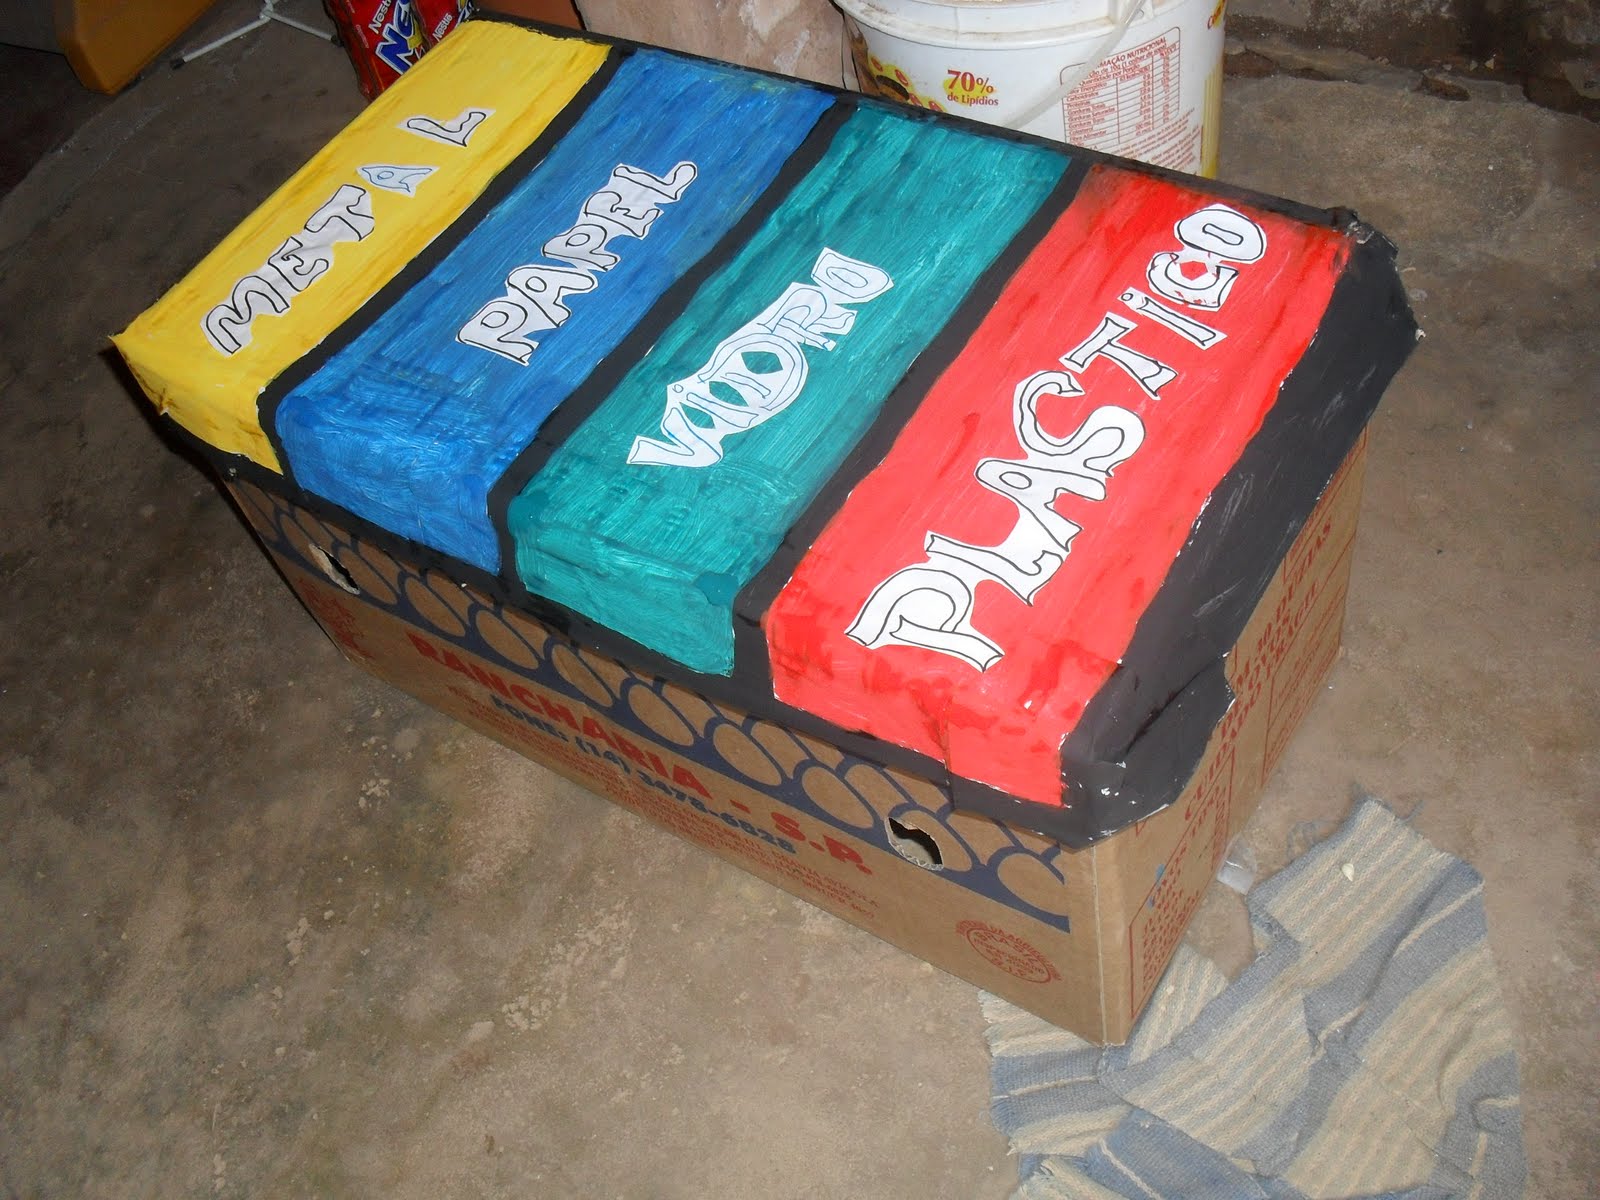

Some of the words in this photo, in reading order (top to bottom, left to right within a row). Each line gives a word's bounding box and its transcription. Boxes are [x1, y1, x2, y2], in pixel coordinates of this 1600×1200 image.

[368, 0, 392, 34] Nest
[947, 91, 959, 102] de
[961, 94, 999, 107] Lipídios
[948, 69, 994, 94] 70%
[206, 111, 488, 354] METAL
[457, 163, 696, 364] PAPEL
[404, 631, 715, 801] RANCHARIA
[772, 811, 873, 875] S.P.
